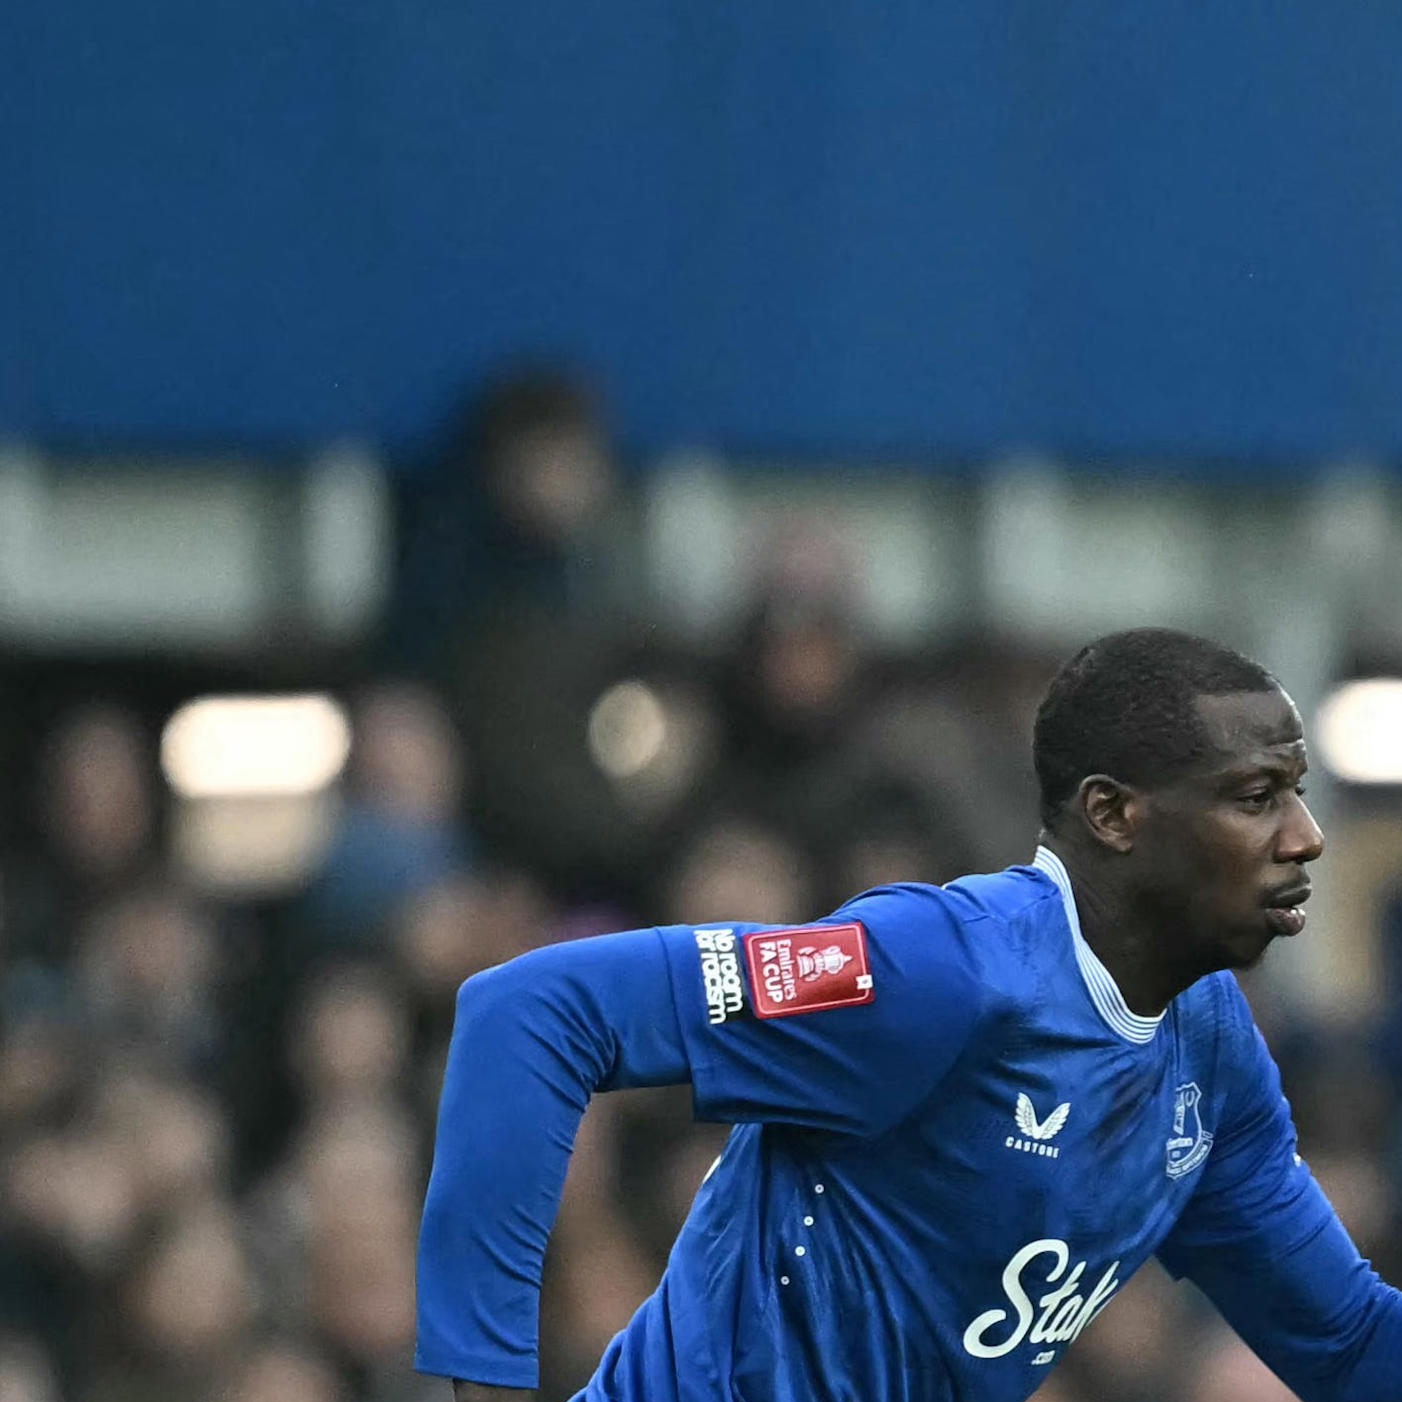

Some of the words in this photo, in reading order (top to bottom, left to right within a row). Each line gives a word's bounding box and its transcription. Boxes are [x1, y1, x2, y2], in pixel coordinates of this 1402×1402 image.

[718, 952, 743, 1013] room
[759, 941, 778, 964] FA
[762, 963, 784, 1003] CUP
[776, 938, 798, 1001] Emirates
[700, 952, 727, 1025] racism
[1005, 1135, 1060, 1159] CASTORE
[963, 1238, 1120, 1359] Stak
